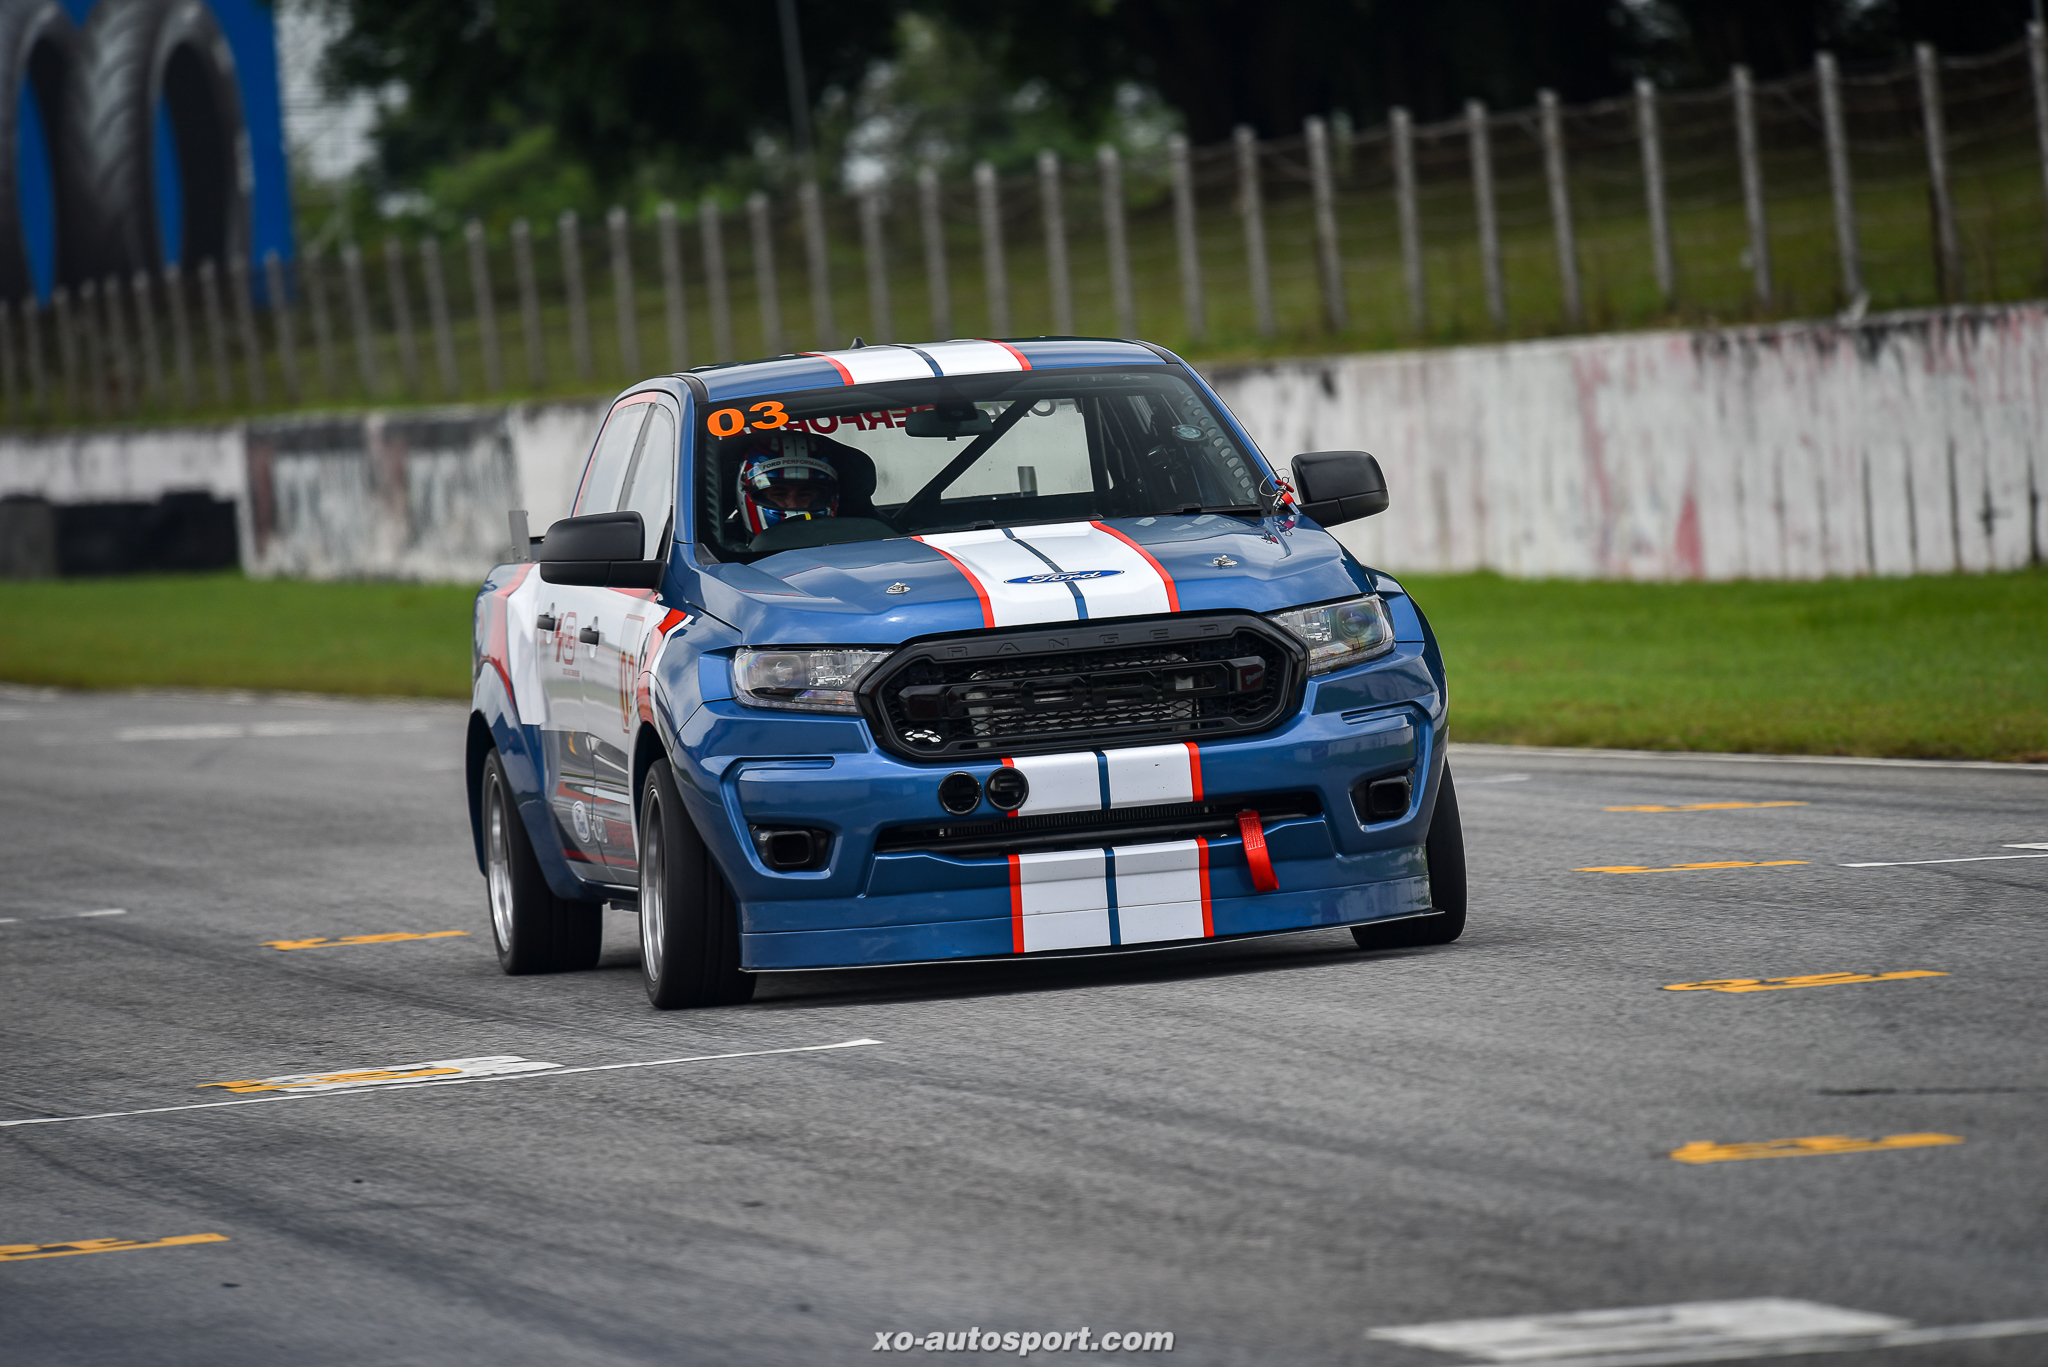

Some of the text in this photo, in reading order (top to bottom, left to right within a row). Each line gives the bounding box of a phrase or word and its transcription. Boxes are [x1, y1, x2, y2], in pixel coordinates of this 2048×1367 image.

[706, 400, 789, 437] 03
[763, 461, 781, 470] FORD
[1023, 571, 1104, 584] Ford
[947, 624, 1219, 657] RANGER
